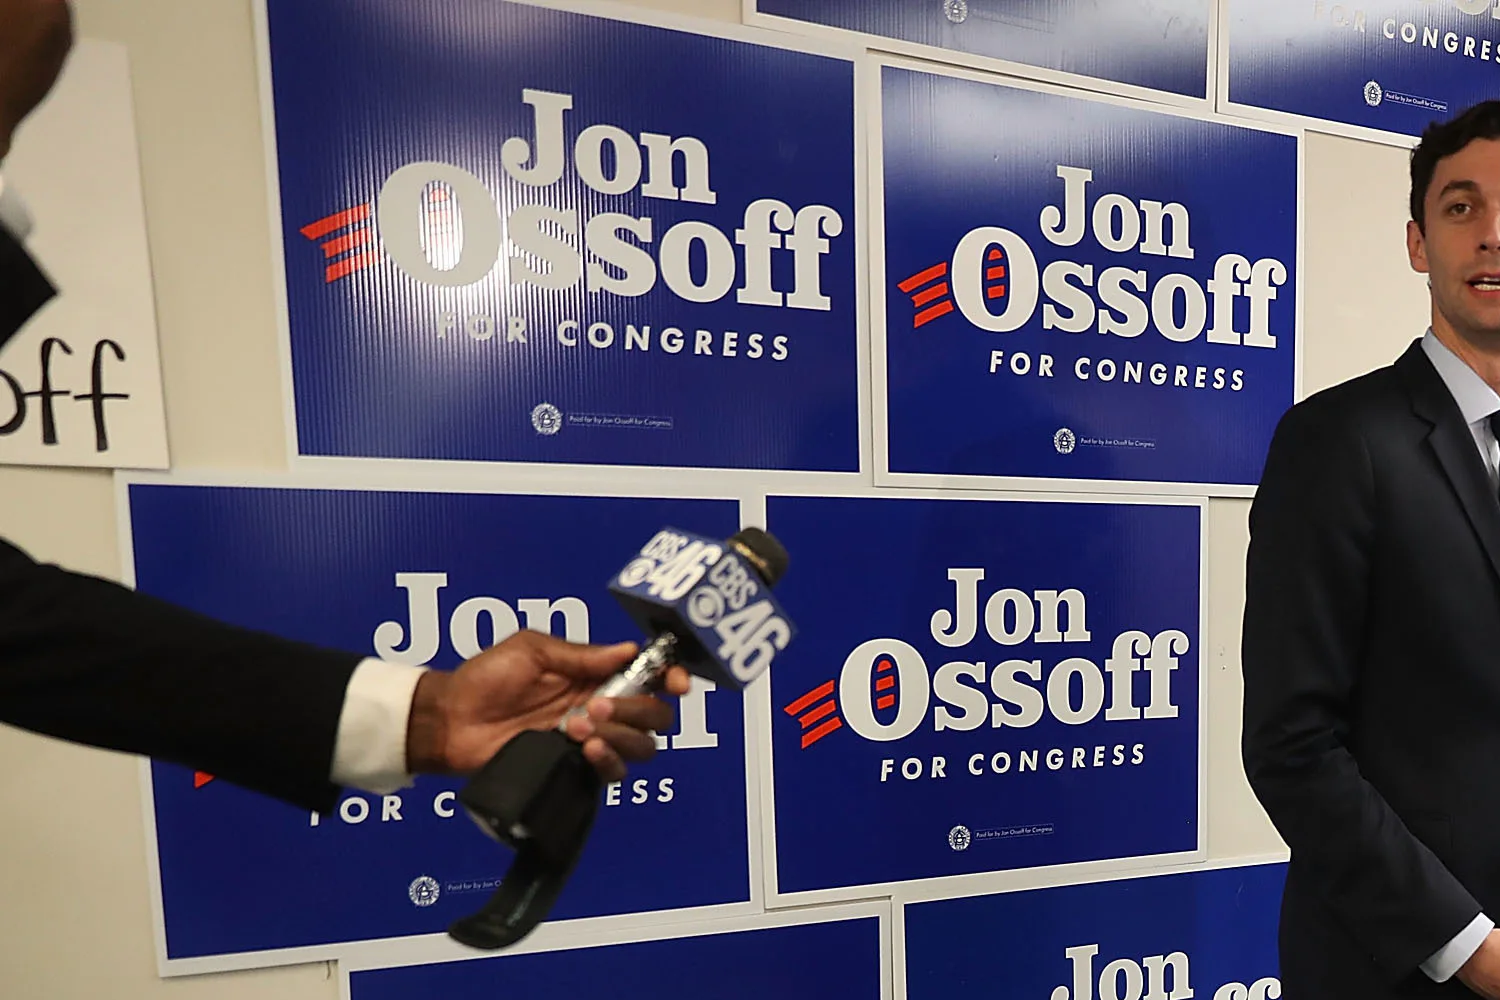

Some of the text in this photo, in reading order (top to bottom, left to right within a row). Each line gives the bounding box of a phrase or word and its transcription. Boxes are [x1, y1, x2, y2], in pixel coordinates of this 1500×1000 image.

[501, 88, 717, 205] Jon
[378, 161, 844, 312] Ossoff
[1040, 165, 1194, 259] Jon
[951, 226, 1288, 348] Ossoff
[437, 312, 790, 361] FOR CONGRESS
[989, 351, 1245, 391] FOR CONGRESS
[640, 530, 689, 562] CBS
[645, 540, 723, 600] 46
[708, 553, 758, 610] CBS
[373, 572, 590, 667] Jon
[714, 600, 791, 682] 46
[930, 568, 1091, 648] Jon
[839, 629, 1189, 742] Ossoff
[310, 777, 675, 826] OR CESS
[880, 743, 1145, 783] FOR CONGRESS
